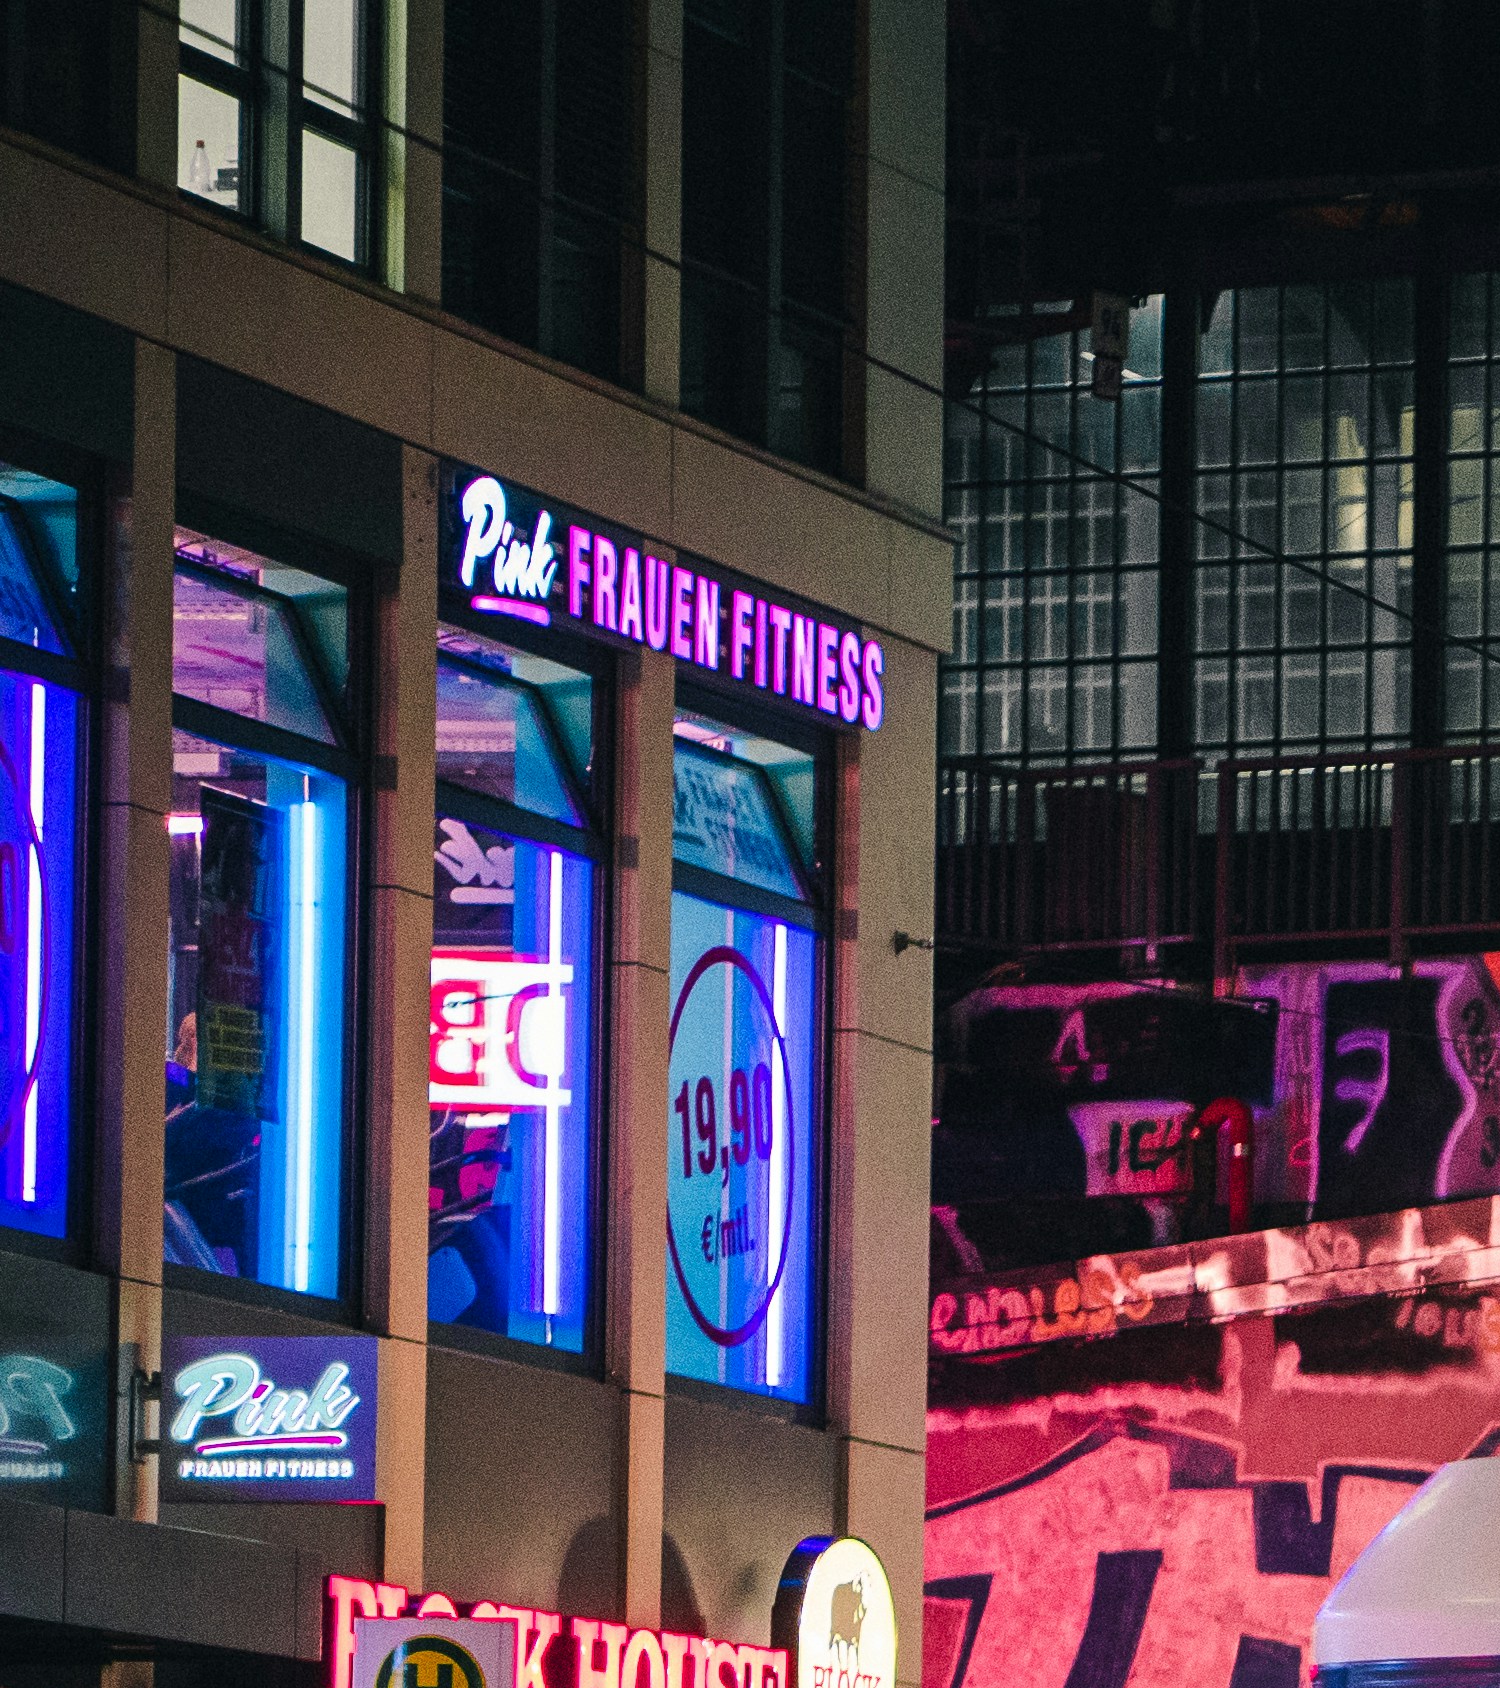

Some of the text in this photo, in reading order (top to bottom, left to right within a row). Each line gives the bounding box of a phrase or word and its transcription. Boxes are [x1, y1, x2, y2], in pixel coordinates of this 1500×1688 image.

[459, 476, 885, 732] Pink FRAUEN FITNESS
[674, 1063, 773, 1188] 19,90
[170, 1354, 361, 1441] Pink
[179, 1459, 355, 1480] FRAUEN FITNESS
